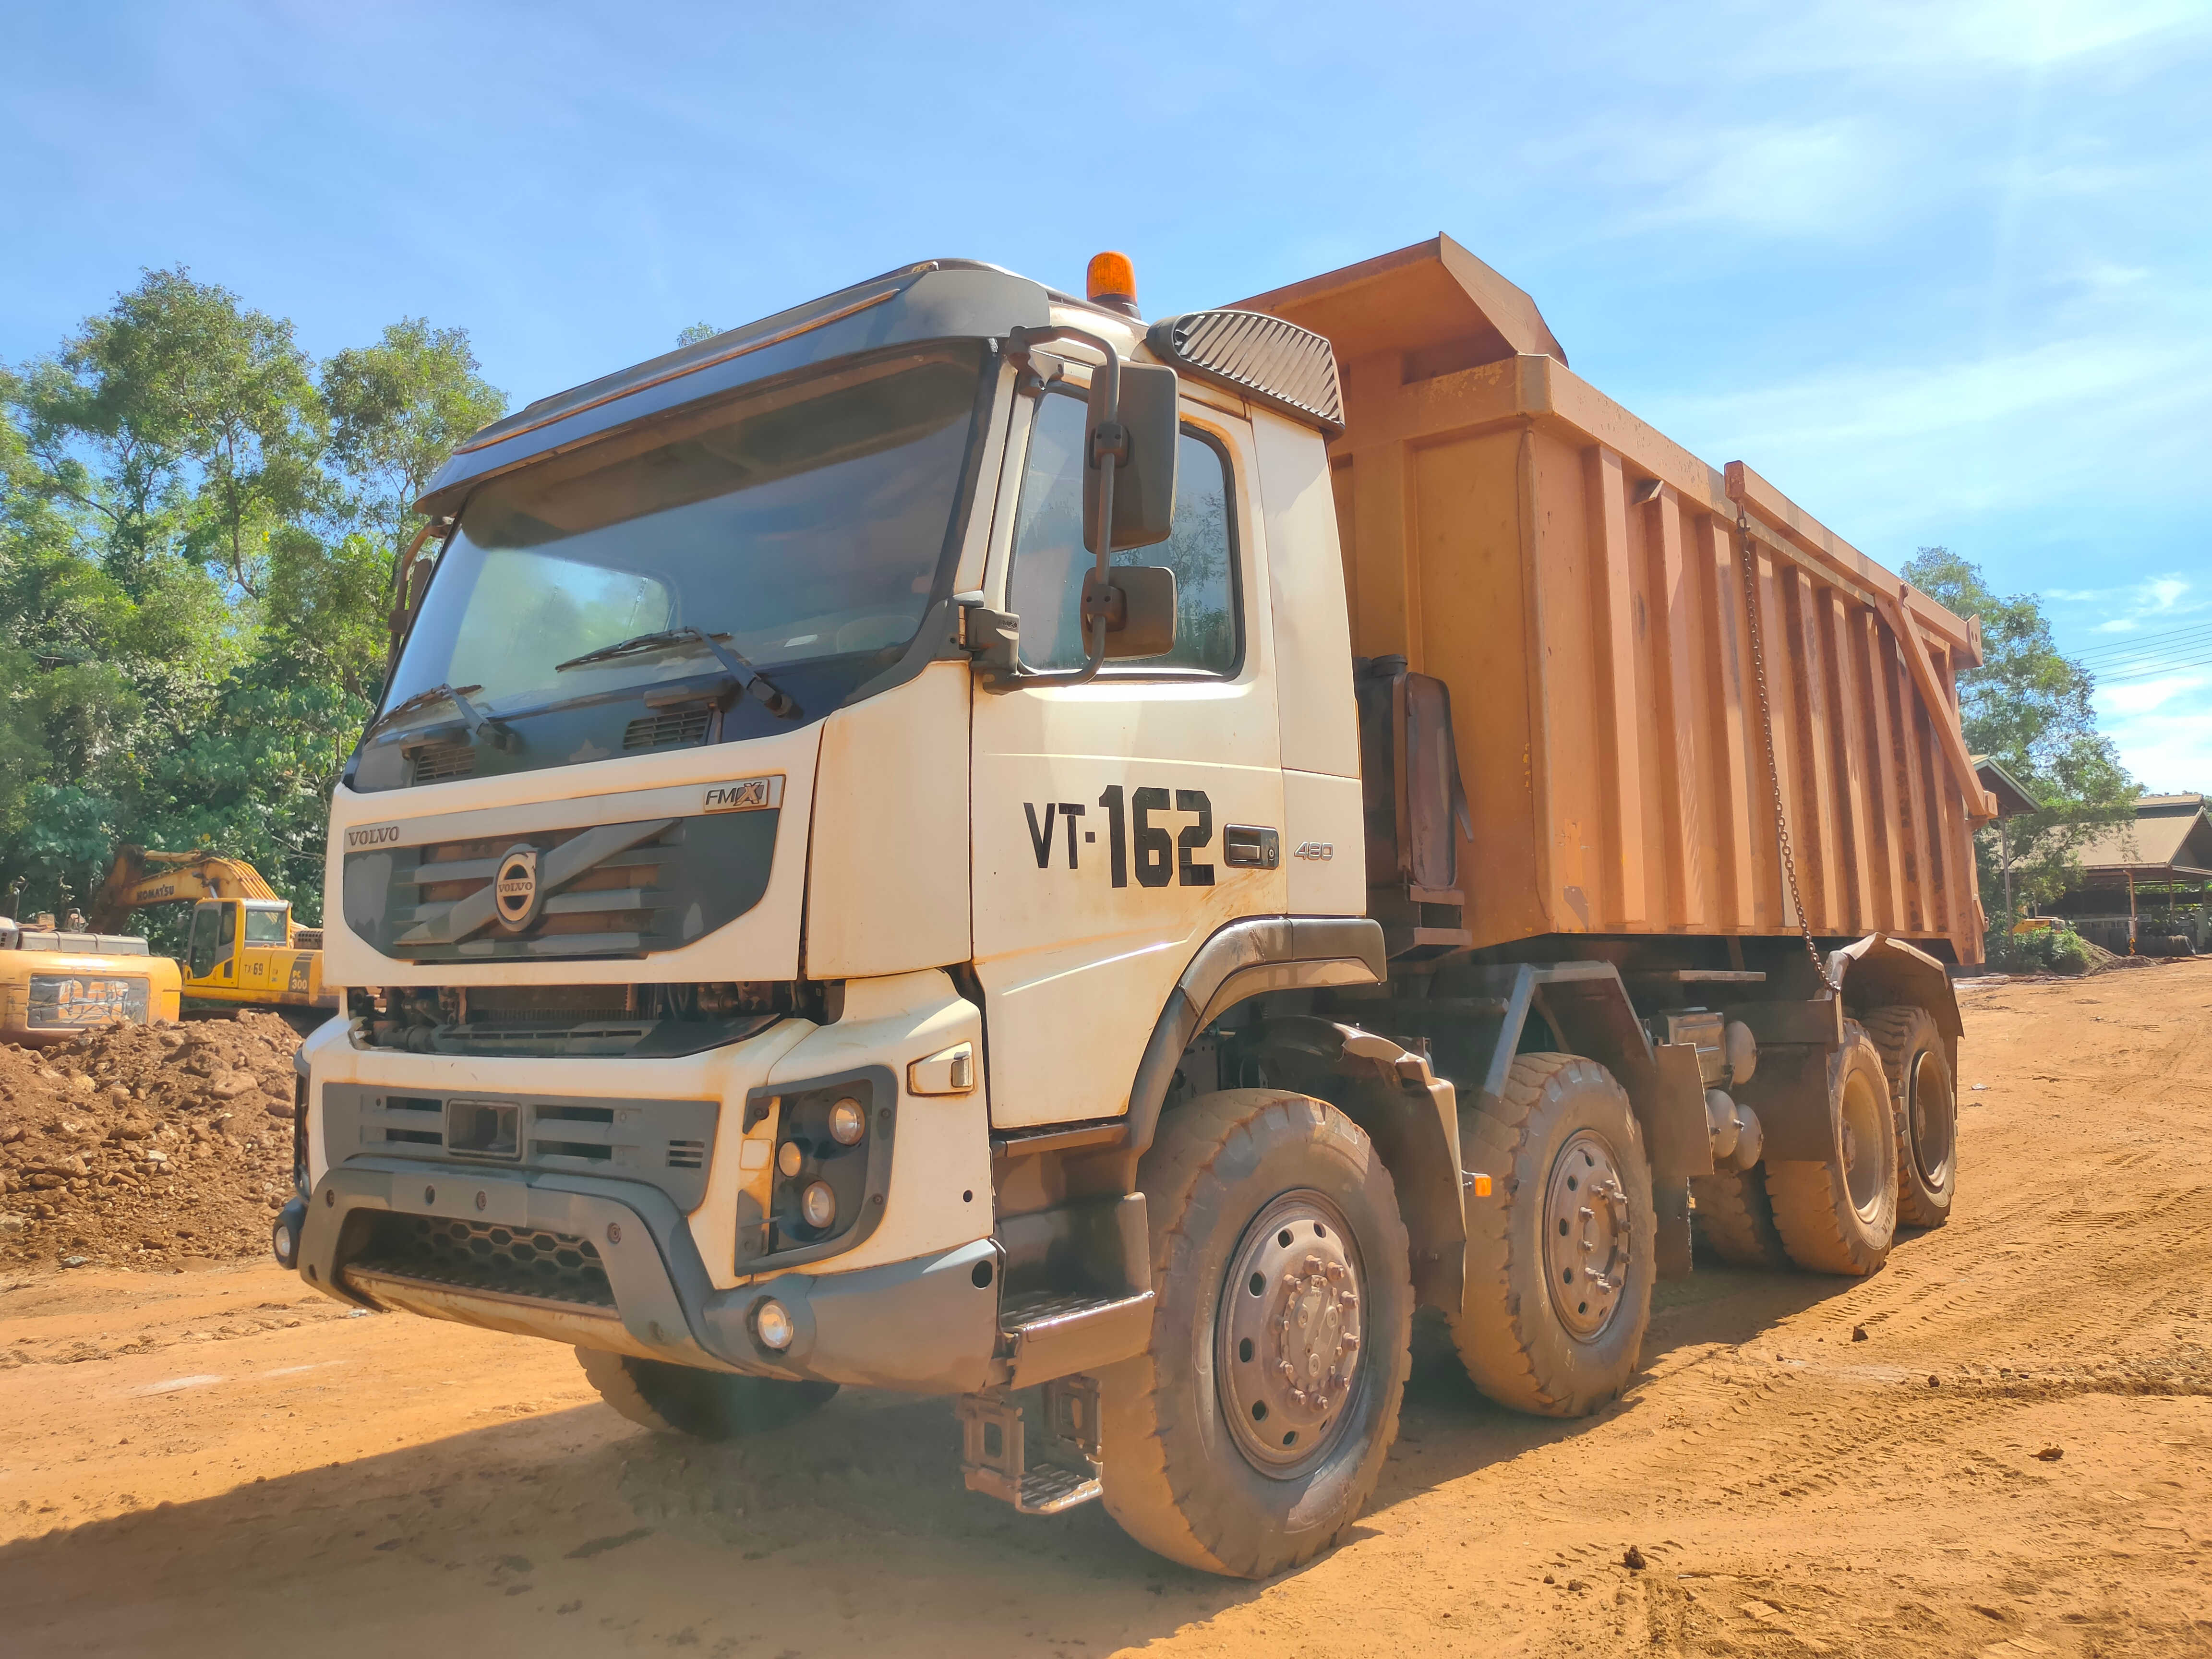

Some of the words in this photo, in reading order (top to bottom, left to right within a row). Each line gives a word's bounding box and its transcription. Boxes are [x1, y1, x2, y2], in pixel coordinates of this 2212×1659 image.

[706, 781, 764, 806] FMX
[349, 826, 400, 846] VOLVO
[1023, 785, 1215, 888] VT-162
[1294, 841, 1333, 860] 480
[137, 884, 174, 901] KOMATSU
[498, 882, 533, 892] VOLVO
[292, 979, 307, 989] 300
